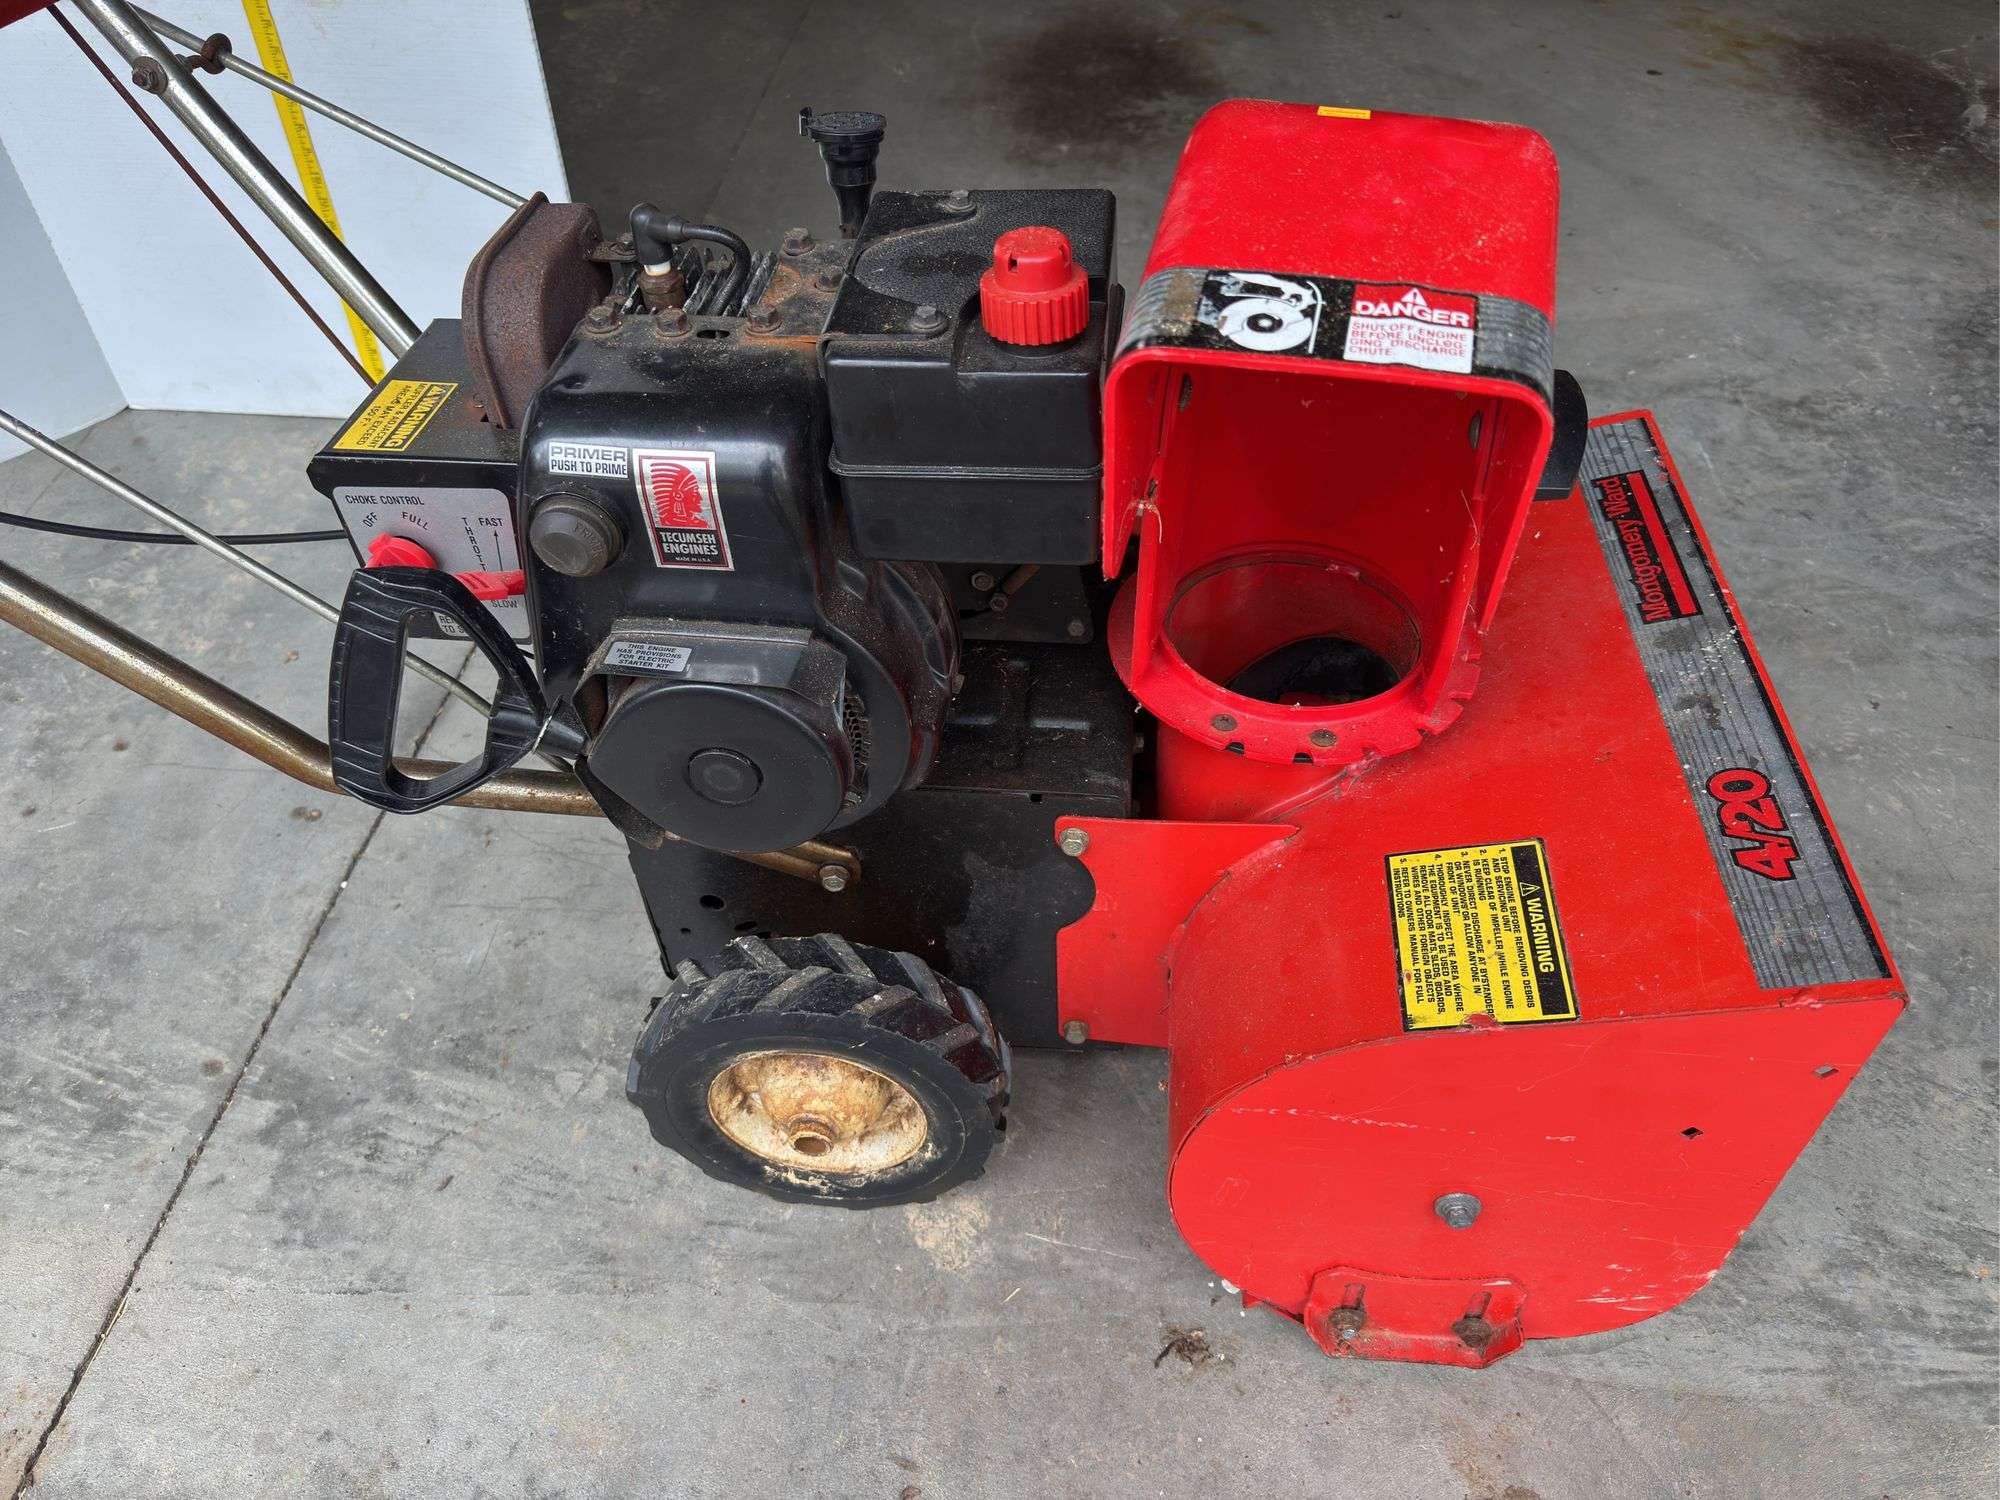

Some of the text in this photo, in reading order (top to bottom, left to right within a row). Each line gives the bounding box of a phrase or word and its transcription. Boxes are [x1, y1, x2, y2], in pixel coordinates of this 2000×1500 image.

[1355, 300, 1470, 327] DANGER
[1351, 330, 1401, 340] BEFORE
[1352, 322, 1466, 341] SHUT OFF ENGINE
[1350, 340, 1465, 357] GING DISCHARGE
[399, 383, 427, 409] MUFFLER
[378, 405, 395, 418] MAY
[383, 395, 440, 447] WARNING
[355, 420, 383, 445] EXCEED
[367, 415, 400, 447] ADJACENT
[551, 446, 626, 461] PRIMER
[551, 460, 627, 475] PUSH TO PRIME
[345, 494, 425, 505] CHOKE CONTROL
[362, 511, 378, 528] OFF
[401, 512, 428, 531] FULL
[478, 517, 503, 527] FAST
[461, 517, 487, 571] THROTT
[660, 531, 717, 544] TECUMSEH
[1599, 476, 1672, 620] Montgomery Ward
[662, 543, 719, 555] ENGINES
[492, 599, 518, 609] SLOW
[442, 625, 455, 634] TO
[635, 649, 682, 660] PROVISIONS
[637, 655, 675, 665] ELECTRIC
[647, 645, 677, 653] ENGINE
[618, 659, 653, 668] STARTER
[1705, 767, 1800, 882] 4/20
[1462, 860, 1471, 882] NEVER
[1480, 858, 1489, 875] KEEP
[1500, 856, 1508, 873] STOP
[1400, 867, 1408, 887] REFER
[1410, 866, 1419, 888] WIRES
[1435, 863, 1447, 906] THOROUGHLY
[1446, 862, 1459, 913] FRONT OF UNIT
[1474, 868, 1485, 900] RUNNING
[1484, 877, 1493, 899] CLEAR
[1393, 868, 1404, 917] INSTRUCTIONS
[1403, 890, 1410, 898] TO
[1418, 865, 1428, 892] REMOVE
[1425, 909, 1433, 928] DOOR
[1429, 879, 1440, 919] EQUIPMENT
[1466, 885, 1476, 910] DIRECT
[1491, 857, 1511, 932] AND SERVICING UNIT
[1503, 876, 1514, 903] ENGINE
[1404, 900, 1414, 931] OWNERS
[1488, 902, 1495, 911] OF
[1416, 908, 1425, 931] OTHER
[1442, 910, 1452, 940] INSPECT
[1453, 861, 1481, 993] OR WINDOWS OR ALLOW ANYONE IN
[1509, 906, 1520, 933] BEFORE
[1437, 931, 1444, 941] TO
[1470, 912, 1483, 953] DISCHARGE
[1490, 913, 1502, 949] IMPELLER
[1526, 897, 1554, 973] WARNING
[1409, 934, 1419, 965] MANUAL
[1420, 934, 1430, 965] FOREIGN
[1439, 944, 1445, 953] BE
[1447, 943, 1455, 957] THE
[1515, 936, 1528, 976] REMOVING
[1440, 956, 1449, 975] USED
[1449, 959, 1458, 980] AREA
[1478, 956, 1485, 965] AT
[1497, 952, 1507, 977] WHILE
[1413, 968, 1421, 982] FOR
[1424, 968, 1435, 1002] OBJECTS
[1416, 985, 1424, 1003] FULL
[1444, 979, 1452, 996] AND
[1453, 983, 1463, 1011] WHERE
[1502, 979, 1513, 1009] ENGINE
[1523, 979, 1534, 1007] DEBRIS
